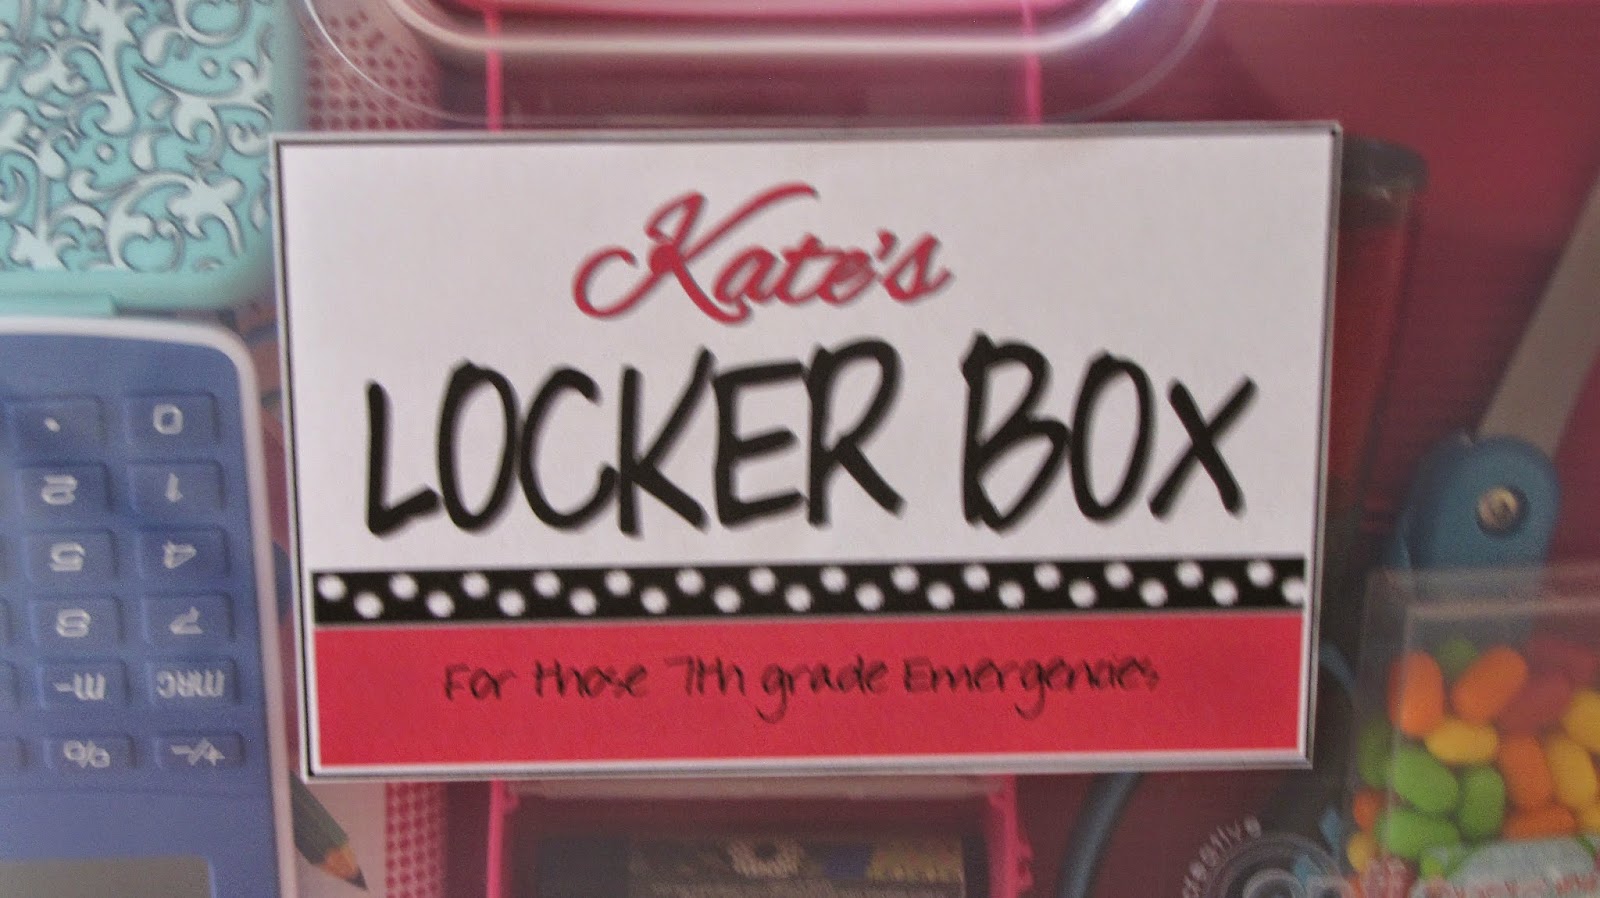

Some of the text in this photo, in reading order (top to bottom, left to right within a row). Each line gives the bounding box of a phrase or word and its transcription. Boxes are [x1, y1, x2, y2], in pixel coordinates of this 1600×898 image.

[571, 182, 953, 325] Kate's
[365, 331, 1257, 539] LOCKER BOX
[41, 474, 78, 505] 2
[164, 472, 184, 503] 1
[50, 542, 86, 572] 5
[163, 540, 197, 570] 4
[168, 605, 203, 635] 7
[444, 653, 1160, 723] For those 7th grade Emergencies
